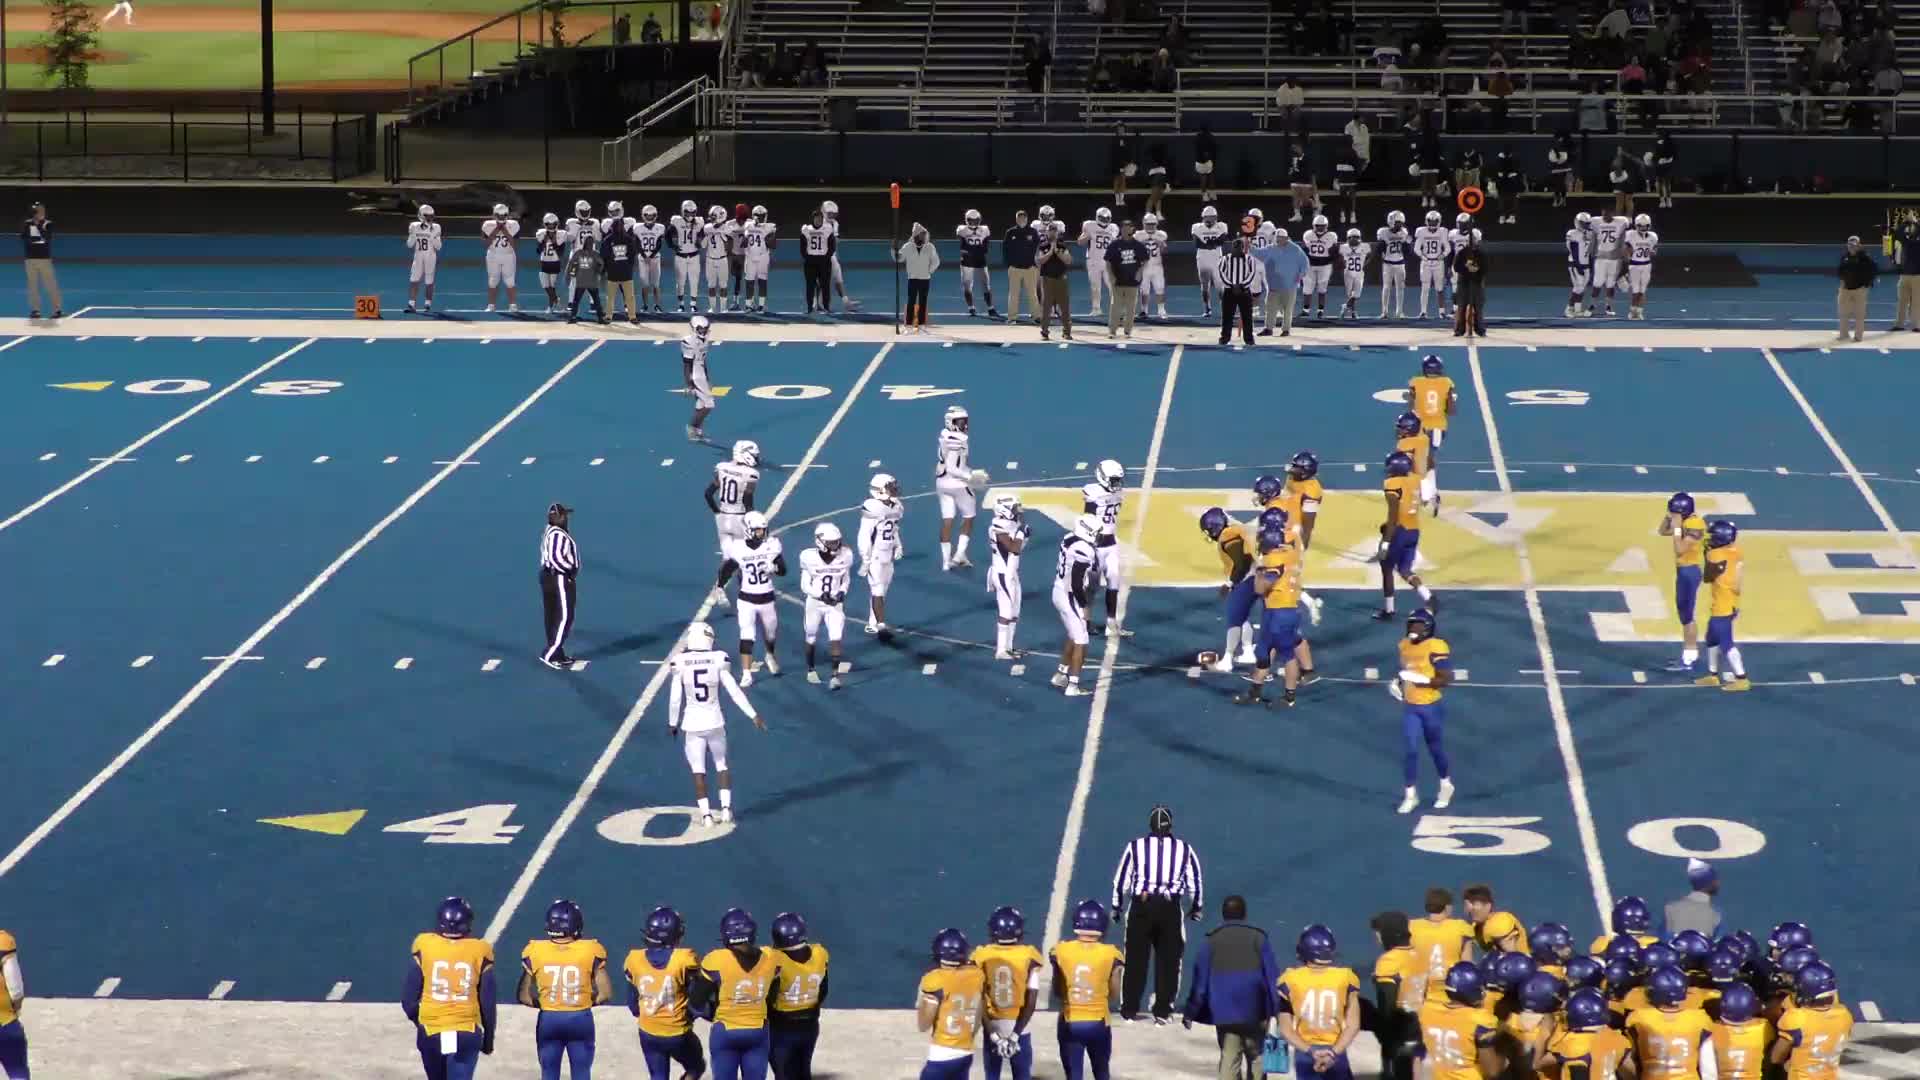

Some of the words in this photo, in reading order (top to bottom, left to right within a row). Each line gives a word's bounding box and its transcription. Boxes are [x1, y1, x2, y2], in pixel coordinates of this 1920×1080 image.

[416, 238, 428, 251] 18
[683, 230, 694, 244] 14
[810, 236, 821, 250] 51
[1601, 231, 1617, 243] 75
[1426, 241, 1438, 254] 19
[1347, 257, 1361, 272] 26
[358, 299, 376, 313] 30
[747, 384, 832, 399] 0
[1426, 390, 1438, 414] 9
[721, 476, 738, 504] 10
[745, 562, 769, 585] 32
[821, 575, 833, 594] 8
[693, 668, 709, 702] 5
[382, 804, 525, 844] 4
[596, 805, 737, 846] 0
[1411, 815, 1552, 856] 5
[1627, 817, 1767, 859] 0
[543, 965, 580, 1006] 78
[994, 965, 1012, 1008] 8
